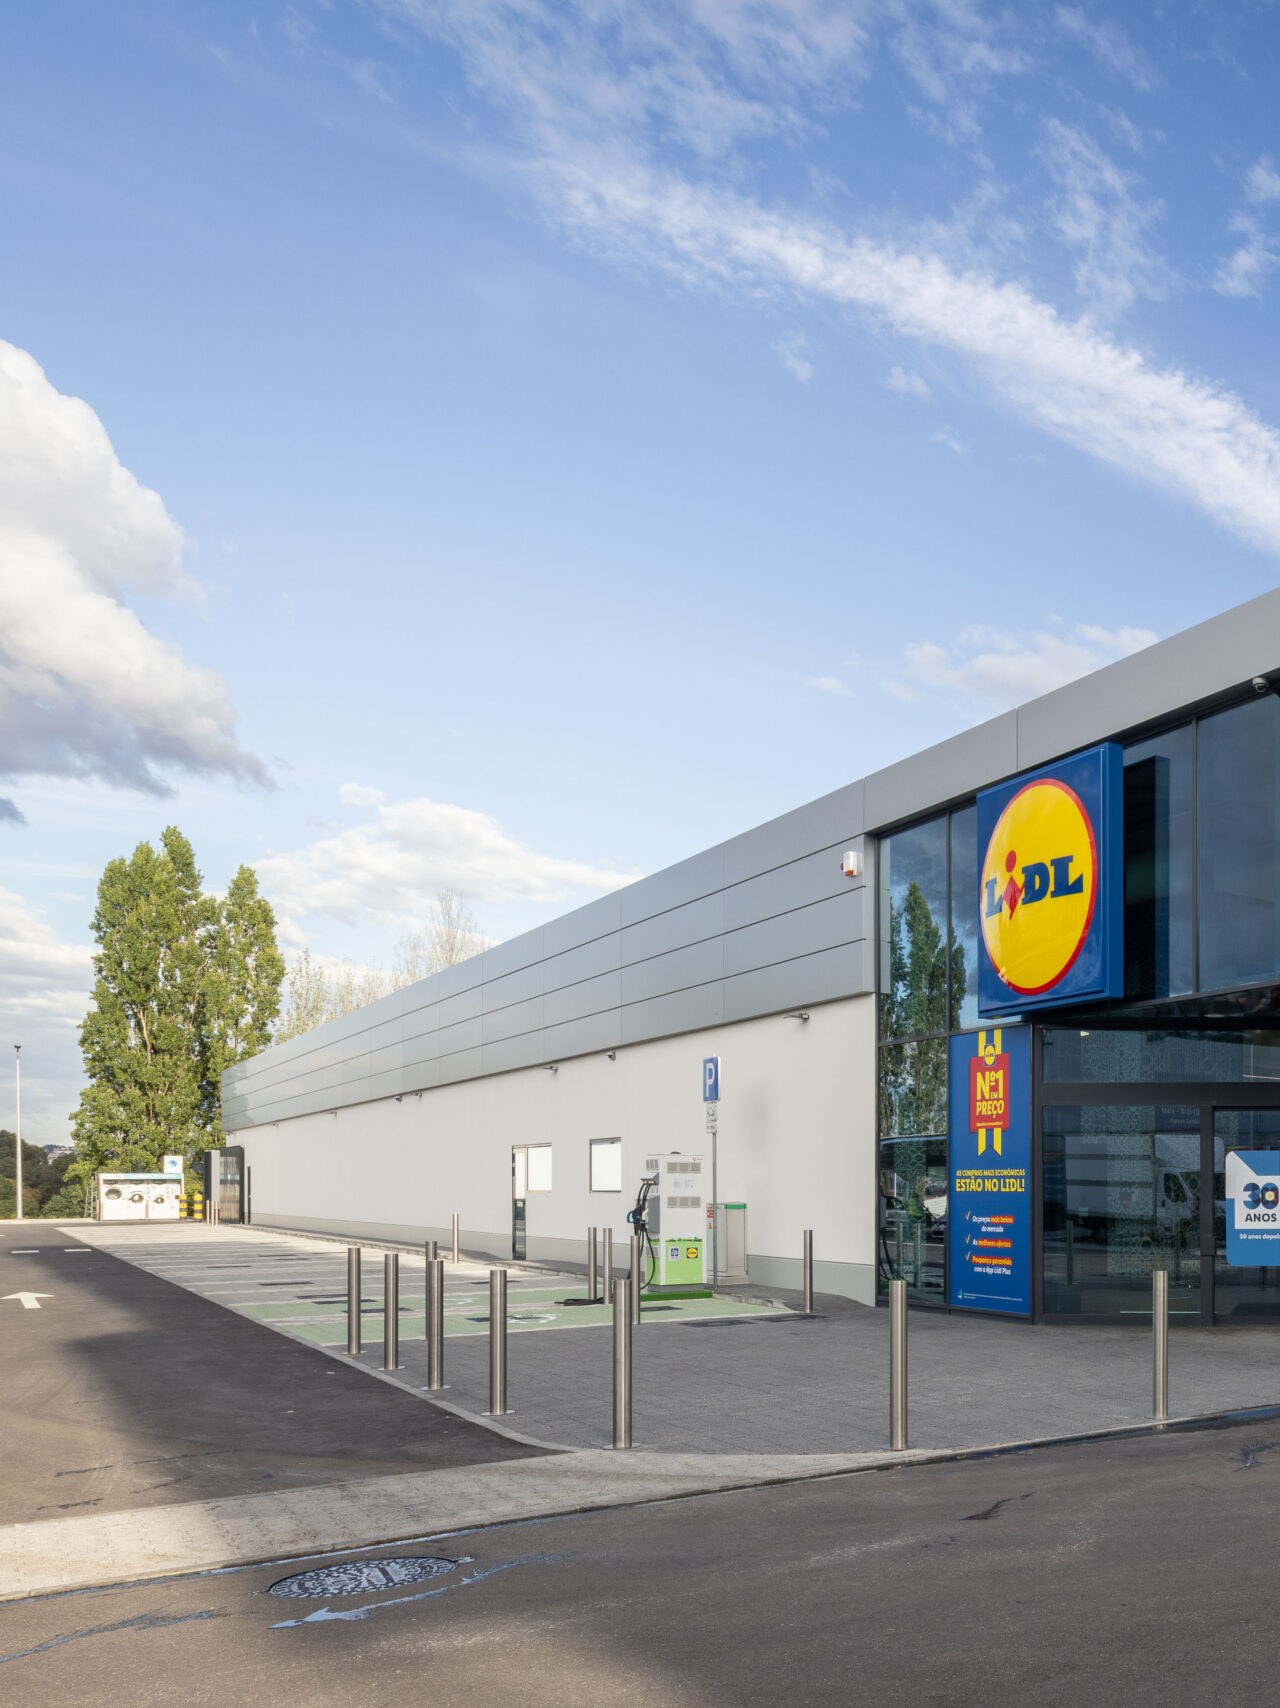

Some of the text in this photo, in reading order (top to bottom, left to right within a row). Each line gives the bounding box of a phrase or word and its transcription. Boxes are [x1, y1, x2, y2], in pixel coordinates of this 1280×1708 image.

[706, 1062, 715, 1097] P
[976, 1100, 1004, 1118] PREÇO
[962, 1169, 983, 1177] COMPRAS
[995, 1168, 1025, 1176] ECONÓMICAS
[956, 1176, 1025, 1192] ESTÃO NO LIDL!
[1243, 1183, 1279, 1210] 30
[1245, 1213, 1277, 1222] ANOS
